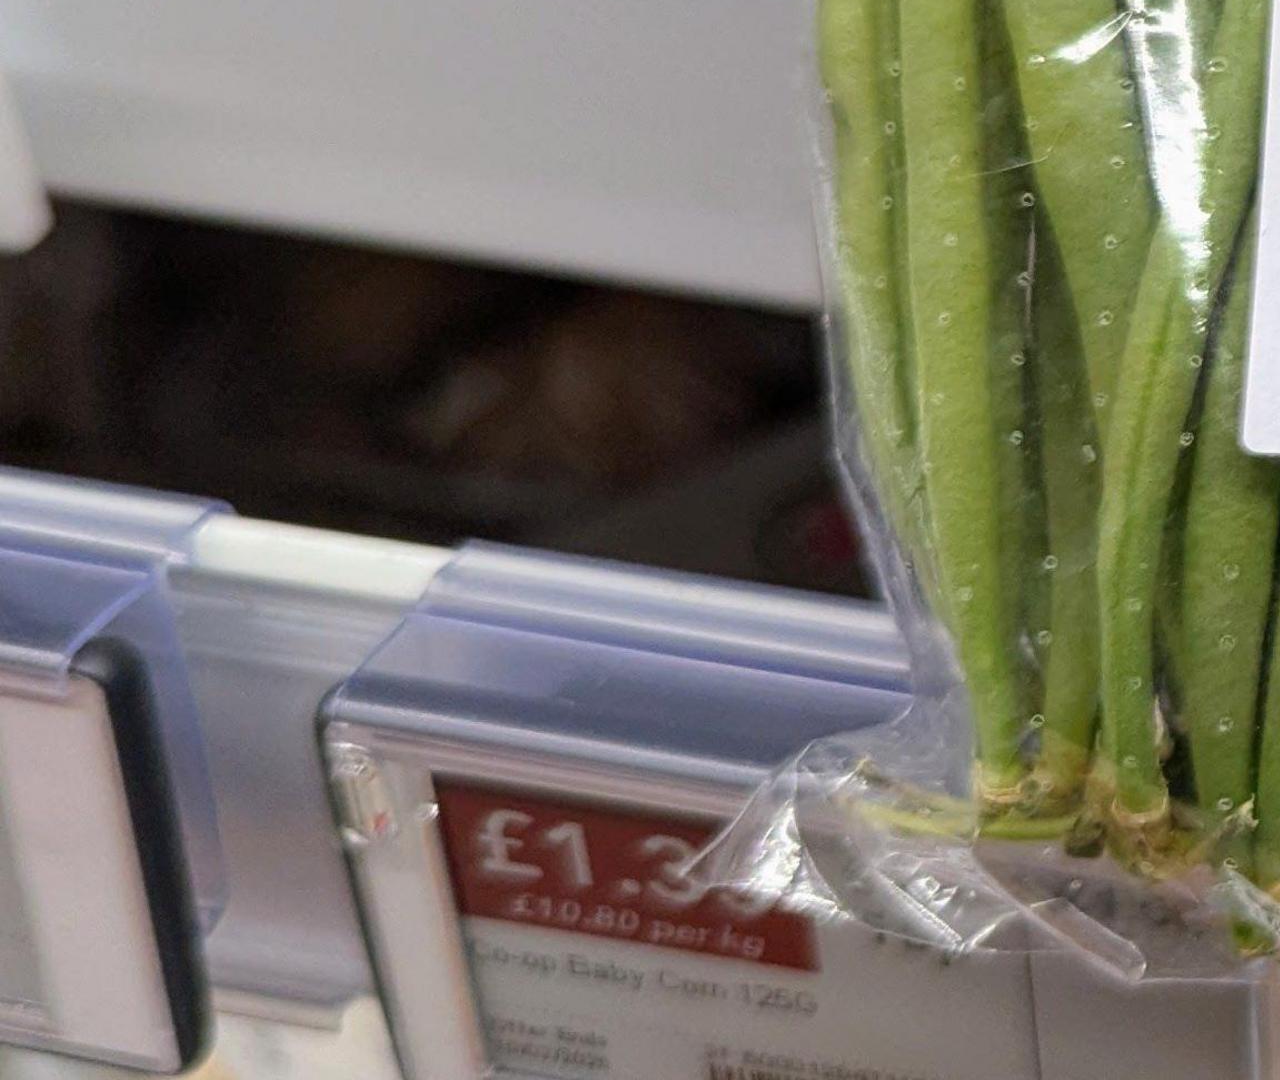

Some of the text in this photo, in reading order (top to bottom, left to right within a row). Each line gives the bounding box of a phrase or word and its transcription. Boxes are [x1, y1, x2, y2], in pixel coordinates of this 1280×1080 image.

[478, 809, 782, 916] £1.3
[653, 920, 708, 947] per
[721, 923, 766, 961] kg
[566, 954, 645, 990] Baby
[659, 970, 727, 1000] Corn
